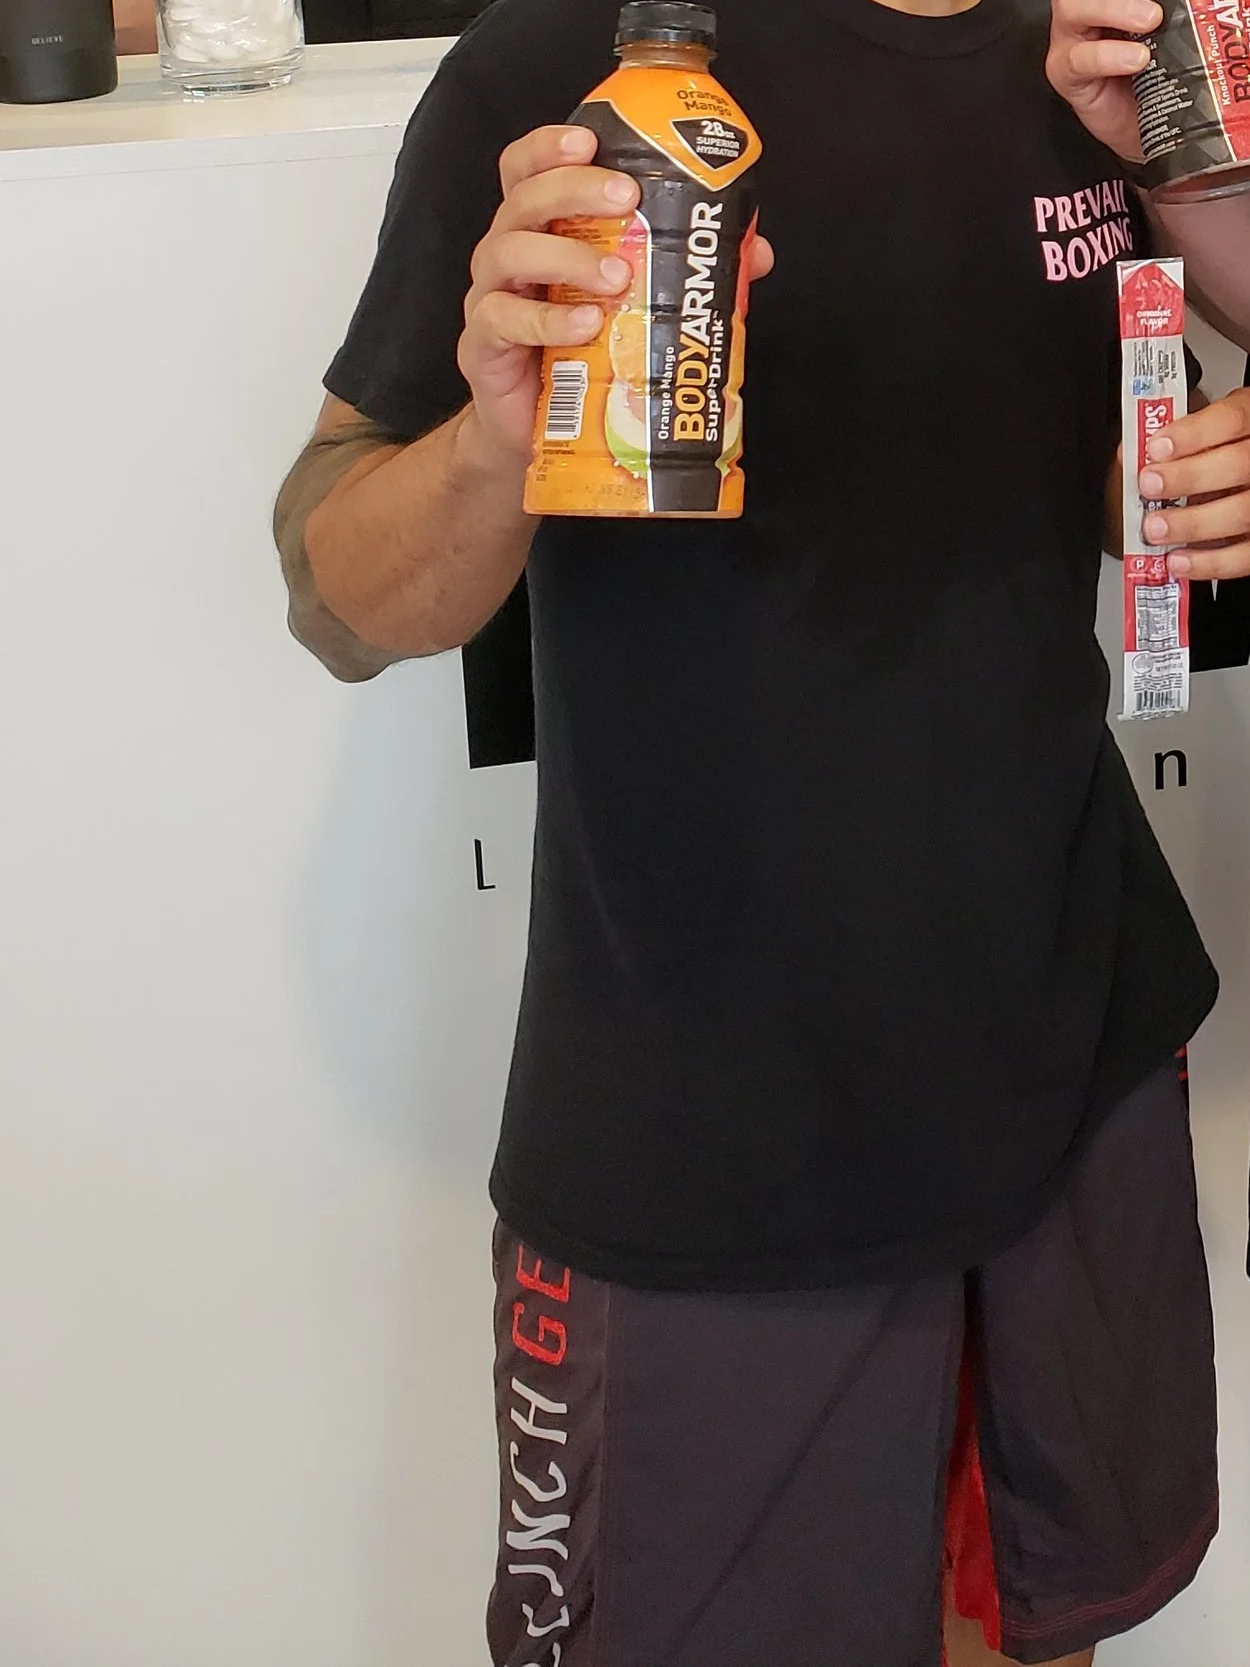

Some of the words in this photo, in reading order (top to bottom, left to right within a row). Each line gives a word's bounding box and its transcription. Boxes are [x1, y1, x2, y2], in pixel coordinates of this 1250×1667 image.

[1207, 24, 1220, 58] Punch
[676, 89, 730, 107] Orange
[1211, 58, 1232, 106] Knockout
[684, 100, 732, 116] Mango
[695, 136, 740, 149] SUPERIOR
[696, 145, 740, 158] HYDRATION
[1033, 179, 1129, 233] PREVAIL
[1041, 217, 1133, 282] BOXING
[673, 201, 724, 442] BODYARMOR
[663, 345, 675, 388] Mango
[658, 389, 672, 441] Orange
